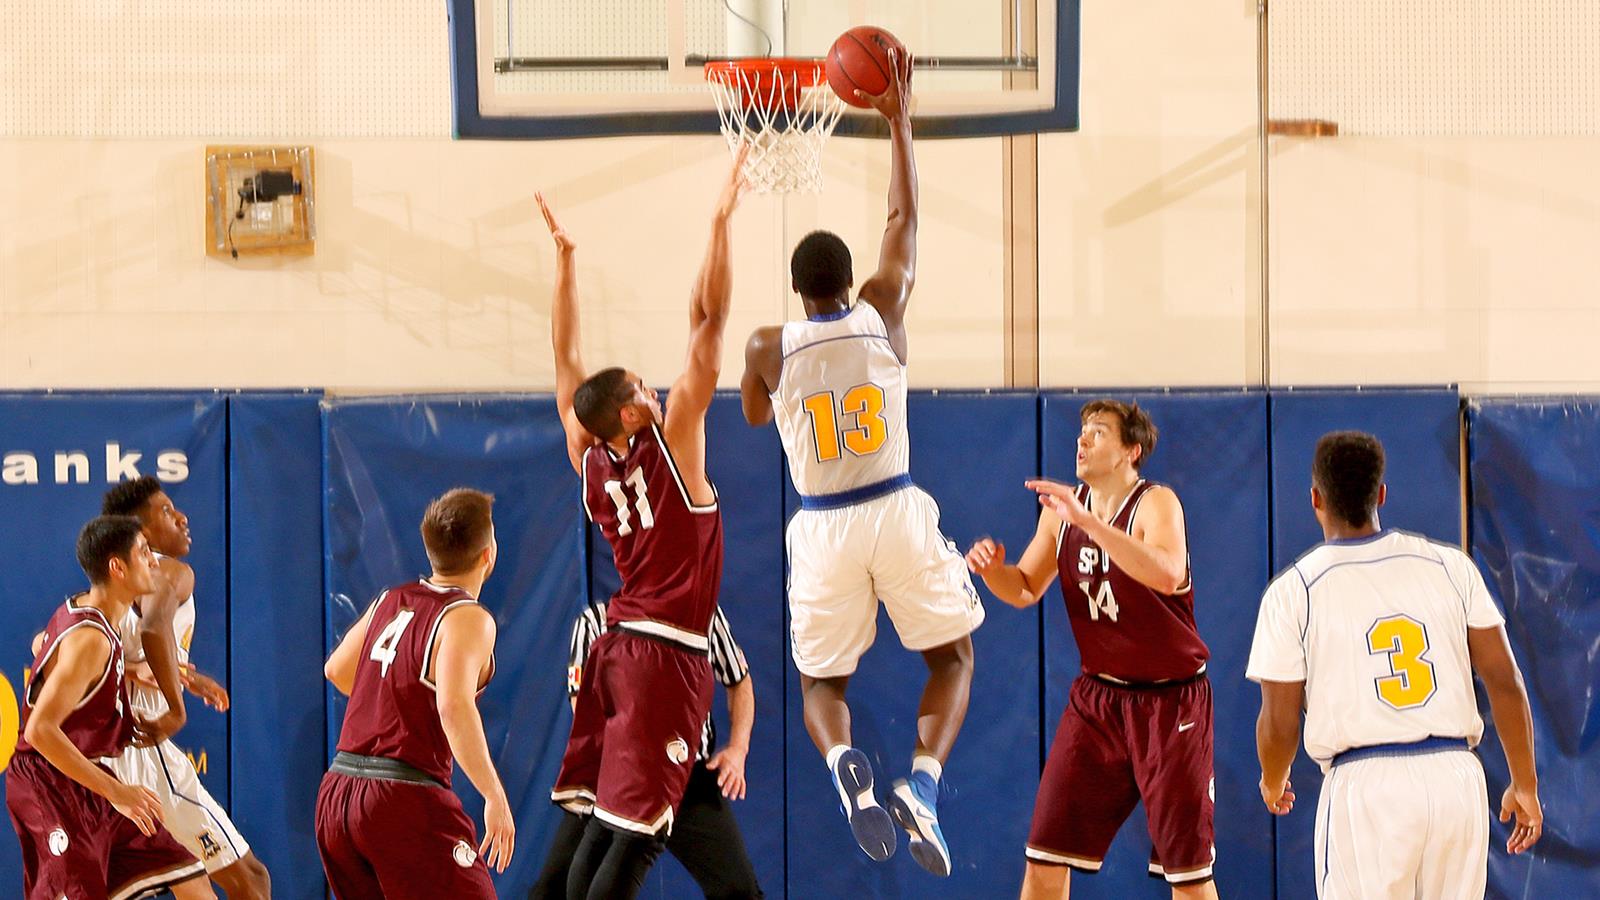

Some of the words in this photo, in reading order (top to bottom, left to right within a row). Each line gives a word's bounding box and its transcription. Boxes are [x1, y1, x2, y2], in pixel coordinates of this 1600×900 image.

[801, 382, 889, 464] 13
[604, 466, 655, 537] 11
[1079, 580, 1119, 622] 14
[369, 609, 415, 678] 4
[1365, 612, 1438, 711] 3
